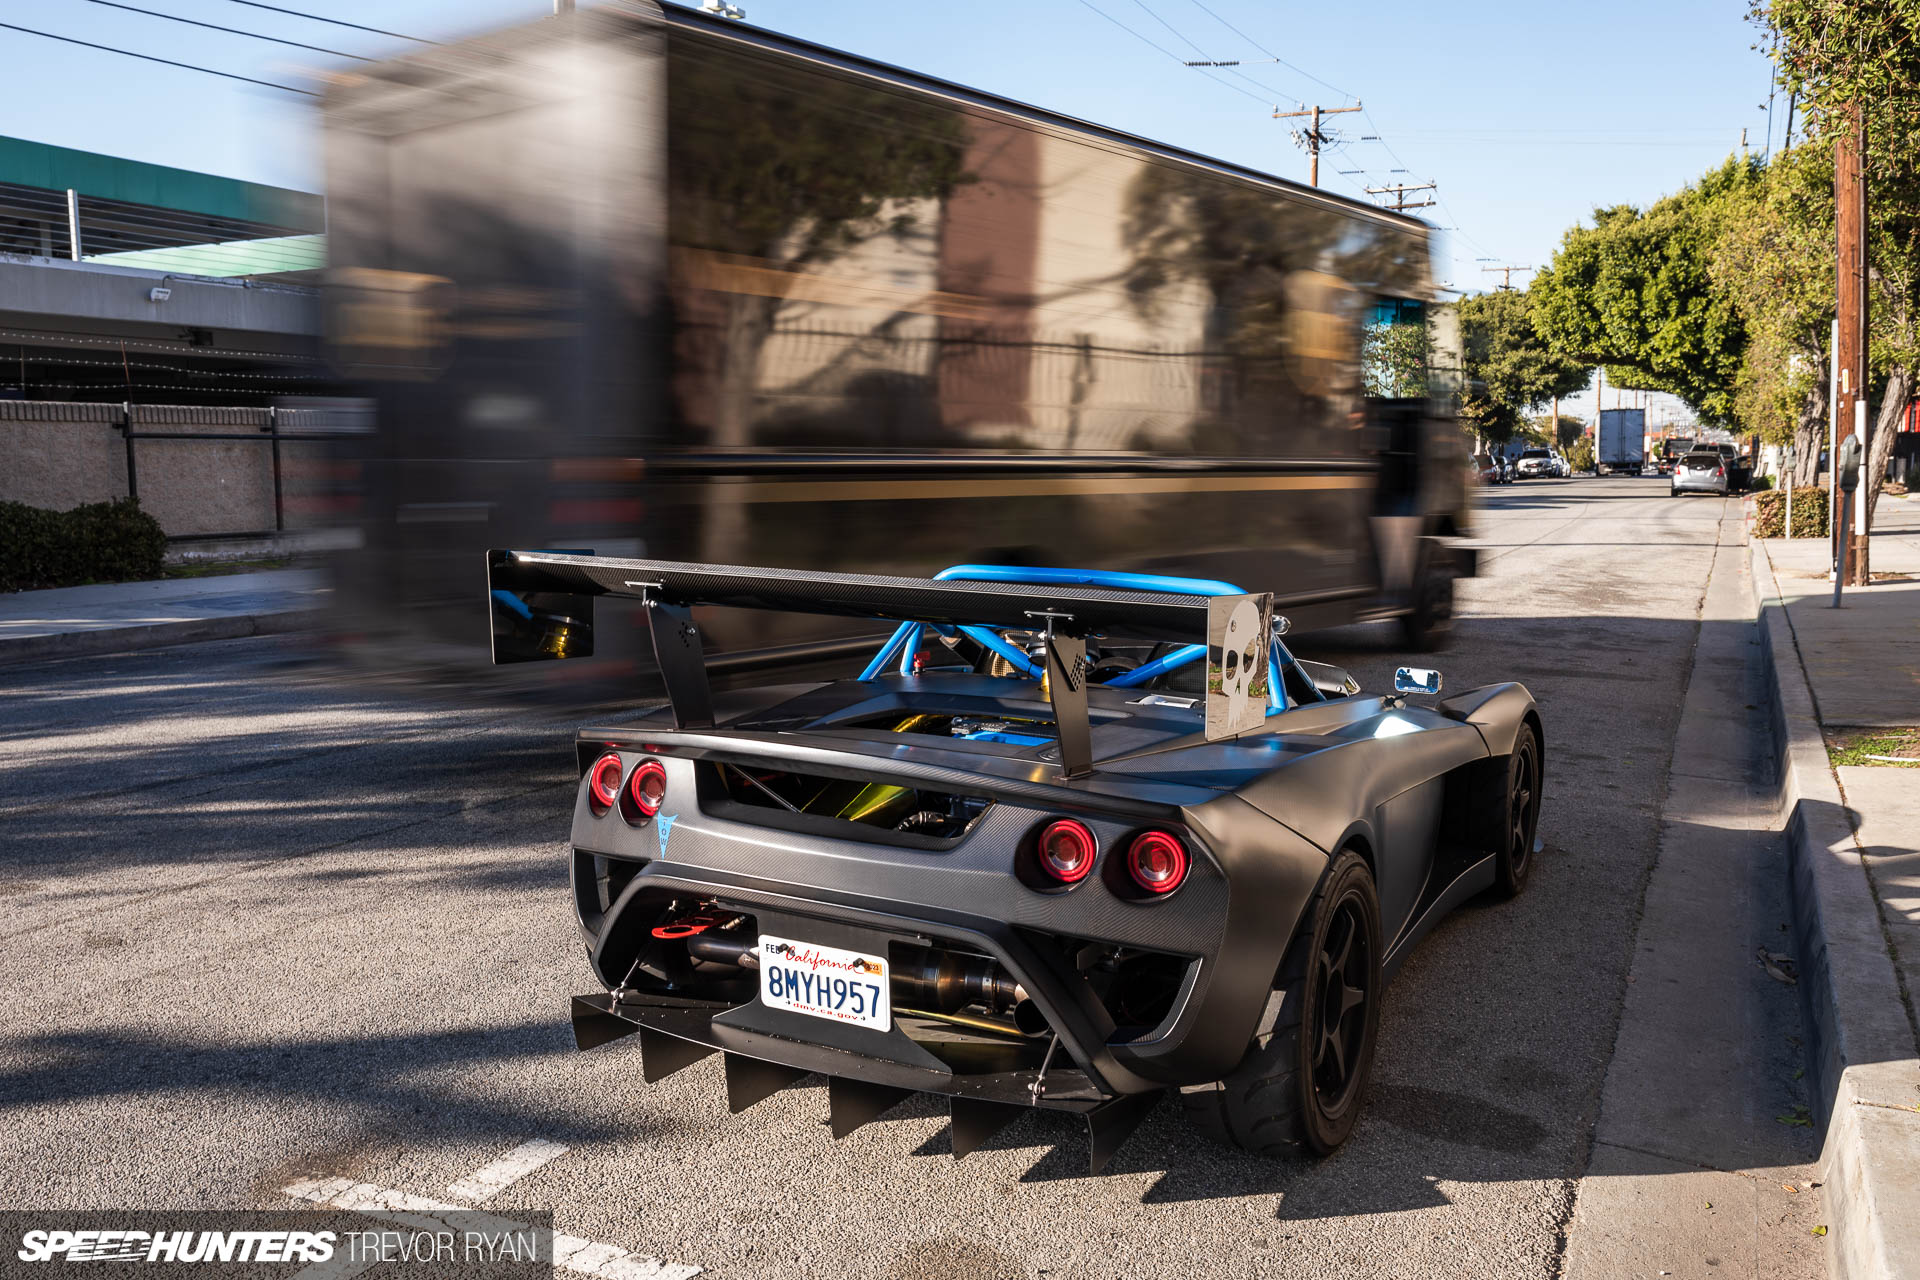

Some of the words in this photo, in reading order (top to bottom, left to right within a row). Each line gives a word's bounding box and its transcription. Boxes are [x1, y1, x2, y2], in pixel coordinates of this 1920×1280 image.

[786, 945, 865, 974] California
[768, 966, 880, 1018] 8MYH957
[793, 1003, 858, 1020] dmv.ca.gov
